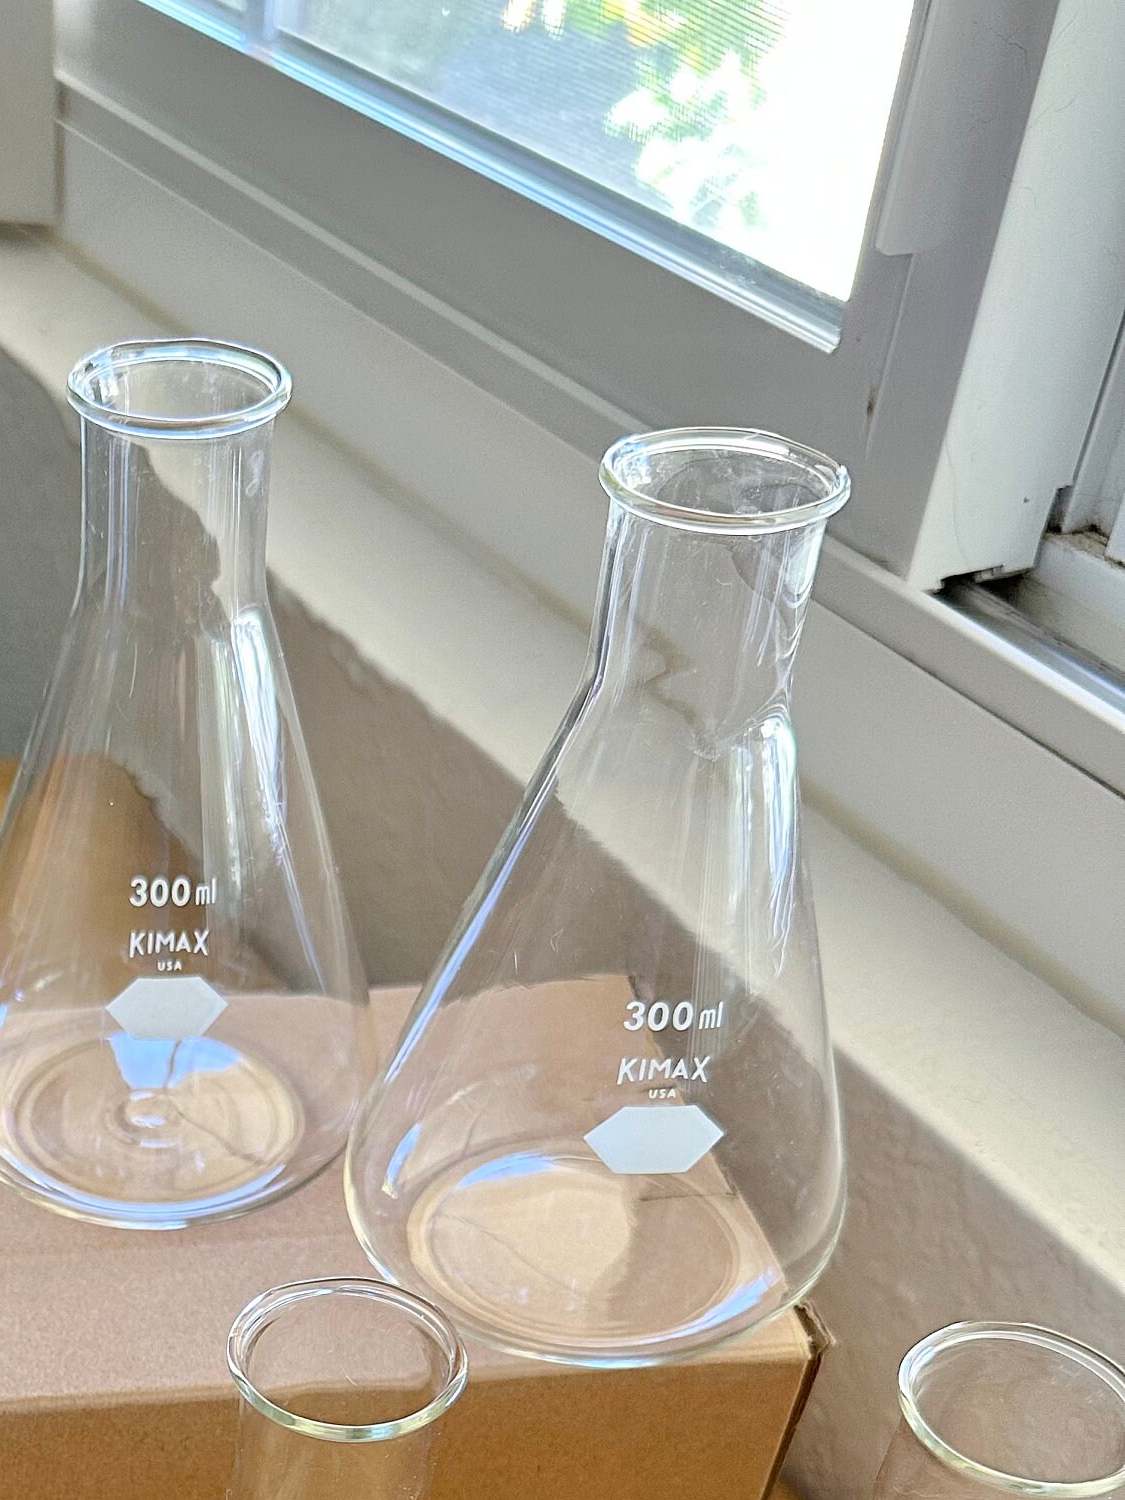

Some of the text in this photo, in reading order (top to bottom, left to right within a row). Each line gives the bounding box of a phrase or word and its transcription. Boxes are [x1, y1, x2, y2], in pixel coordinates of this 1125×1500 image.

[129, 877, 217, 907] 300 ml
[129, 929, 209, 959] KIMAX
[157, 960, 182, 971] USA
[623, 1001, 724, 1032] 300 ml
[617, 1055, 711, 1086] KIMAX
[648, 1088, 677, 1099] USA
